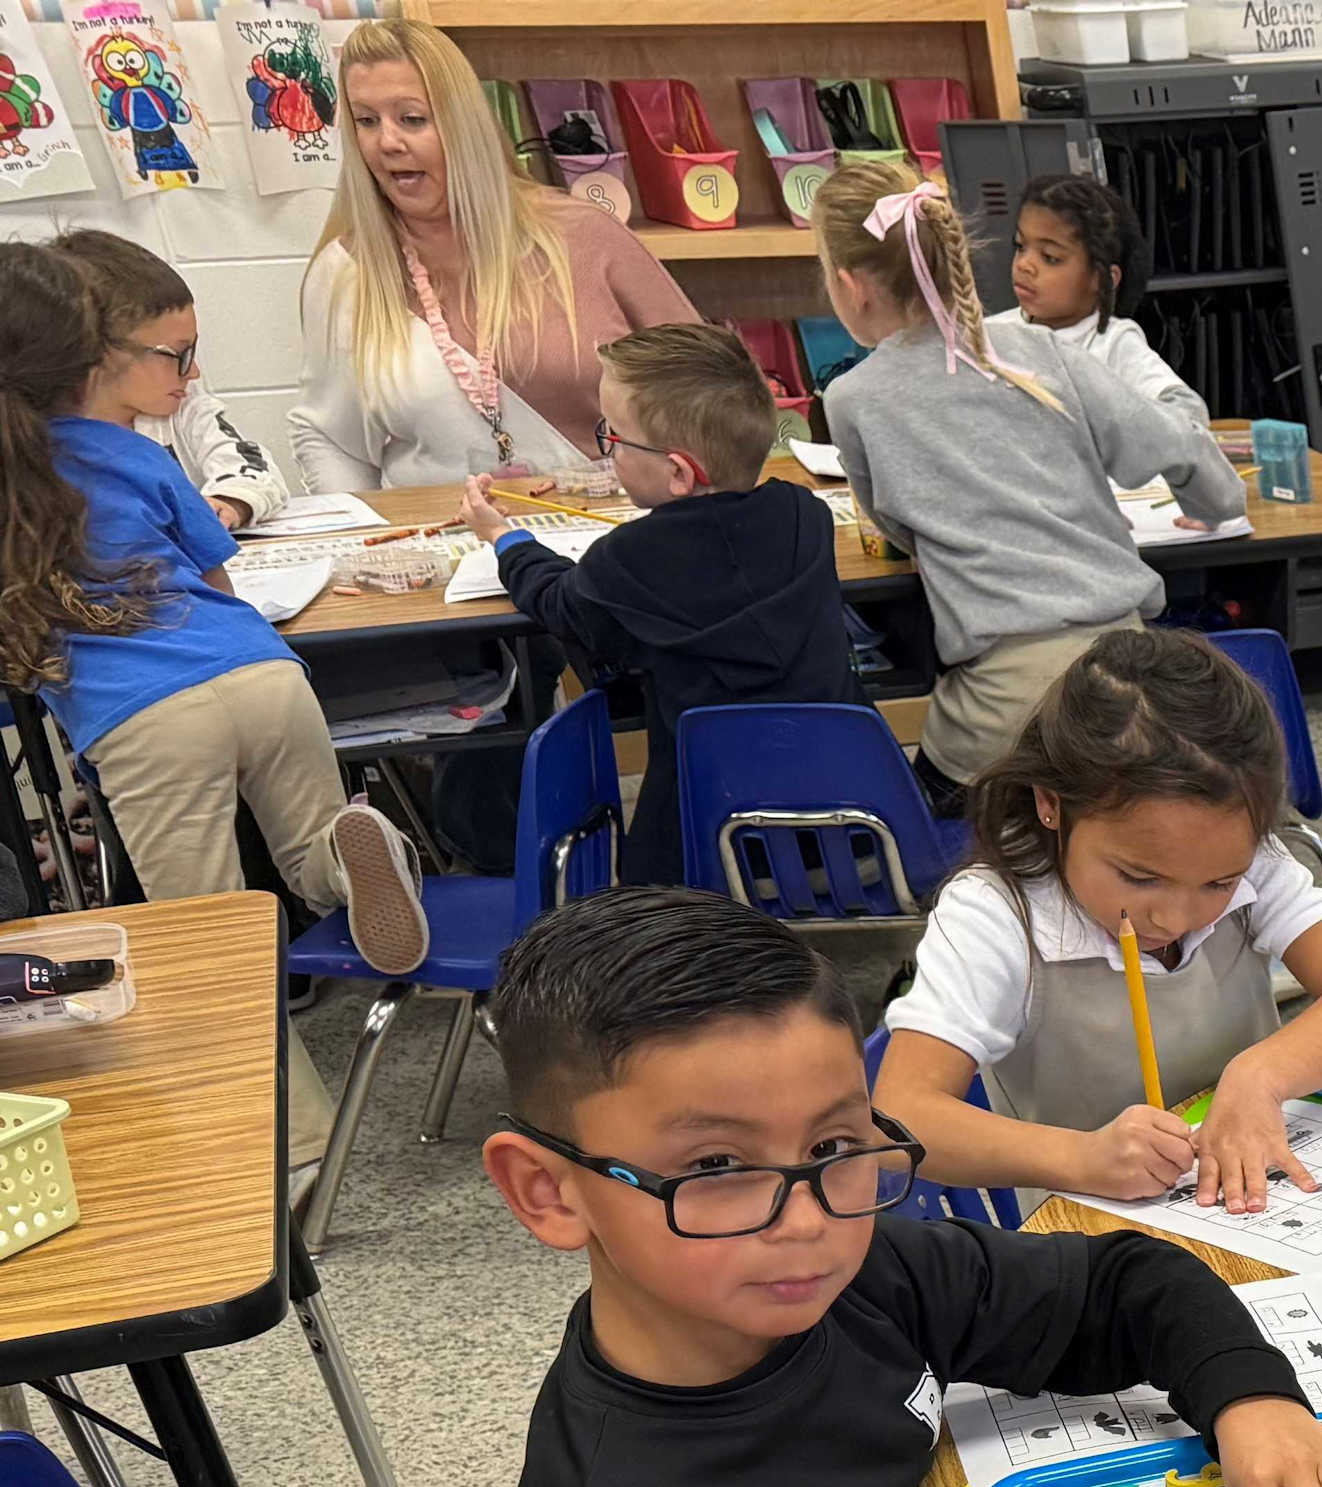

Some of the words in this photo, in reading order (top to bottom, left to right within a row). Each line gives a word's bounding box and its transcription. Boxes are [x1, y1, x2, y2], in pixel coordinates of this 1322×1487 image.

[89, 17, 106, 30] not
[109, 18, 118, 26] a
[254, 20, 273, 30] not
[1256, 27, 1316, 51] Mann
[696, 175, 719, 208] 9
